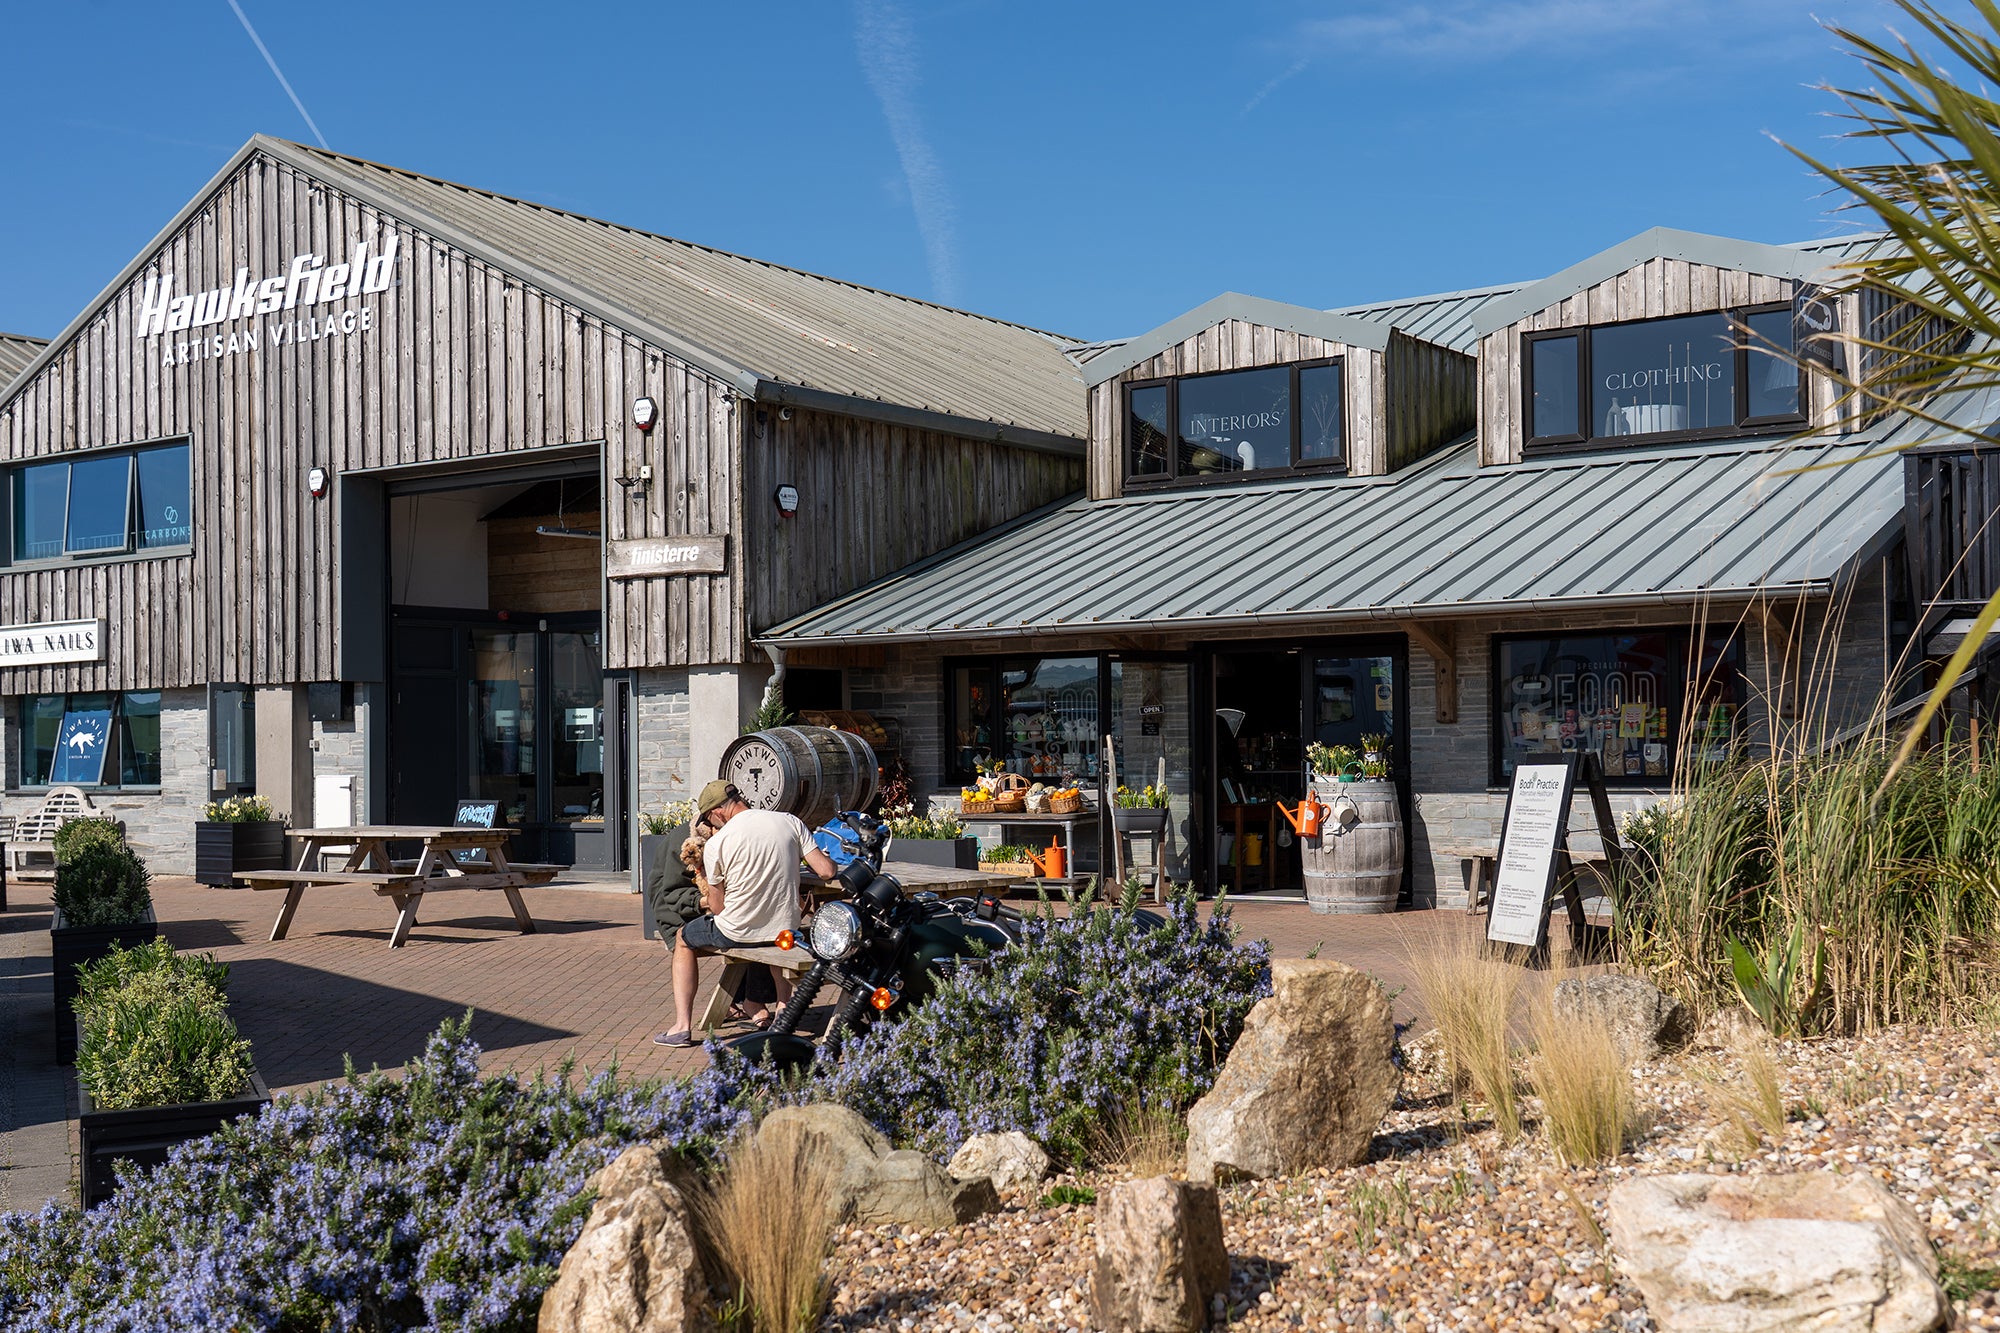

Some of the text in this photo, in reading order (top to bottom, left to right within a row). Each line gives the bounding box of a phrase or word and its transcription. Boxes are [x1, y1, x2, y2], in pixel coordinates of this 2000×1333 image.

[137, 234, 400, 338] Hawksfield
[162, 307, 371, 367] ARTISAN VILLAGE
[1605, 362, 1721, 390] CLOTHING
[1191, 411, 1281, 435] INTERIORS
[631, 544, 700, 566] finisterre
[0, 631, 95, 656] IWA NAILS
[1577, 661, 1629, 670] SPECIALITY
[1555, 671, 1657, 720] FOOD
[1143, 706, 1160, 714] OPEN
[1536, 778, 1560, 790] Practice
[760, 788, 778, 810] ARC
